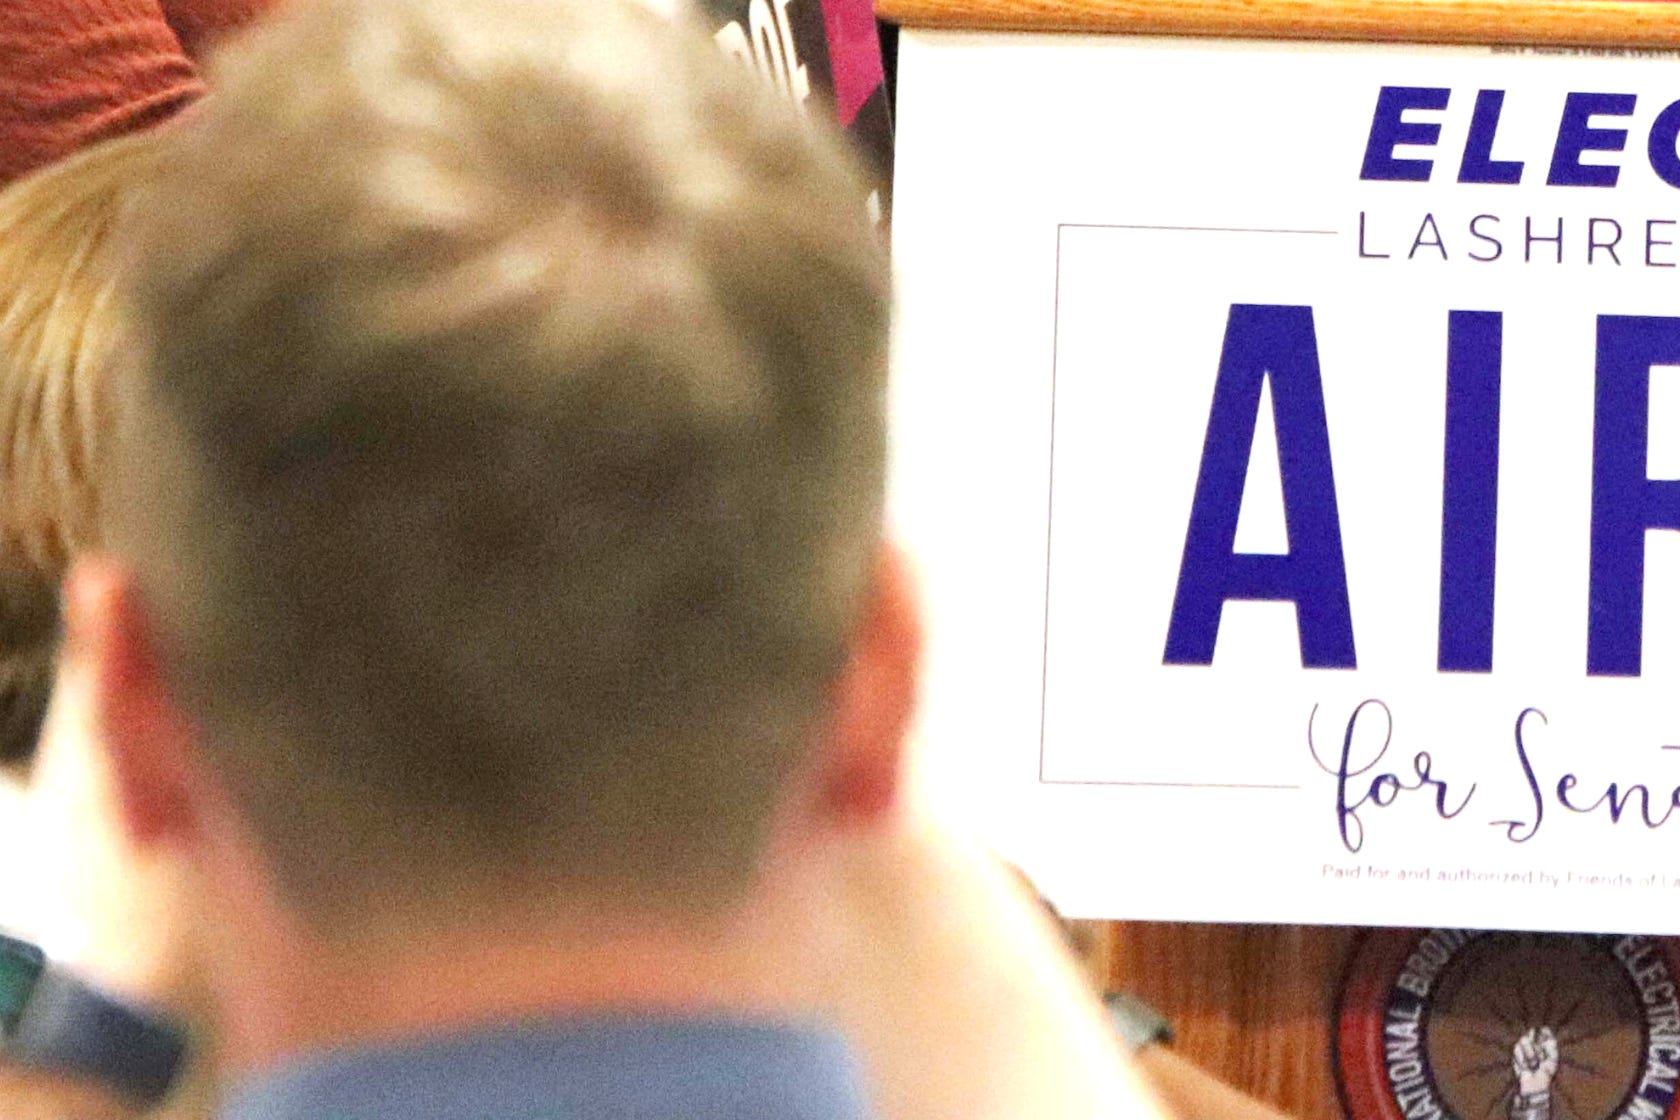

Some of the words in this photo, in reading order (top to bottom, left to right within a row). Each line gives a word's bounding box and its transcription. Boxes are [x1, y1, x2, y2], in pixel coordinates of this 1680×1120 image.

[1307, 698, 1477, 853] for
[1321, 863, 1361, 879] Paid
[1367, 864, 1390, 879] for
[1397, 867, 1431, 881] and
[1436, 868, 1533, 884] authorized
